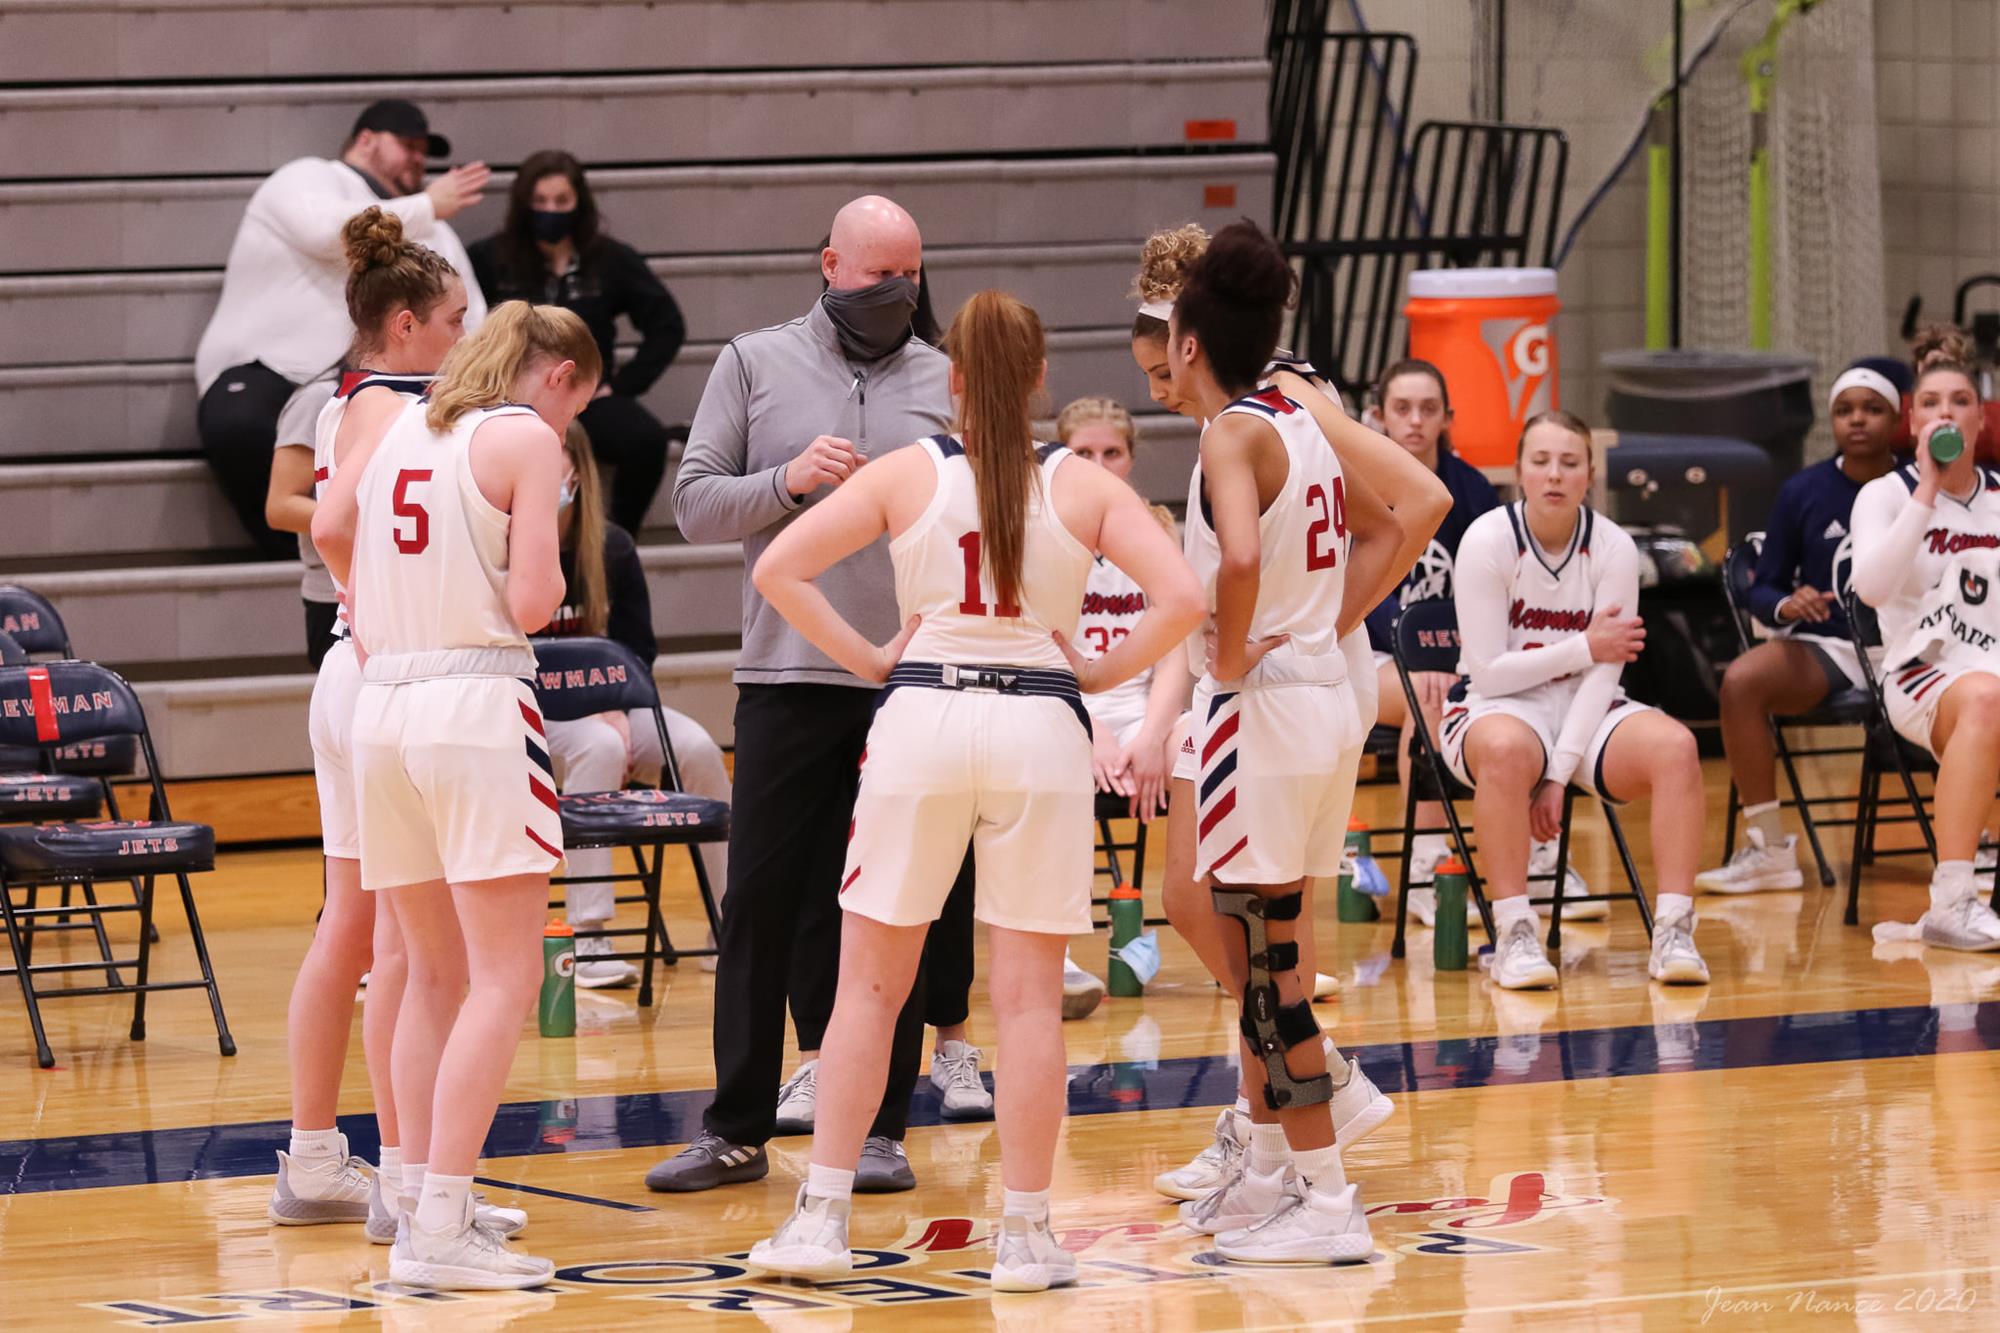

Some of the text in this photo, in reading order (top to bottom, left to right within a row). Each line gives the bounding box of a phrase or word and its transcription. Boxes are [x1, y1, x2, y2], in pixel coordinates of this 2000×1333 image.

[1513, 325, 1549, 376] G
[393, 469, 433, 555] 5
[534, 664, 628, 691] WMAN
[0, 690, 113, 718] EWMAN
[14, 786, 72, 802] JETS
[643, 812, 702, 827] JETS
[118, 837, 179, 856] JETS
